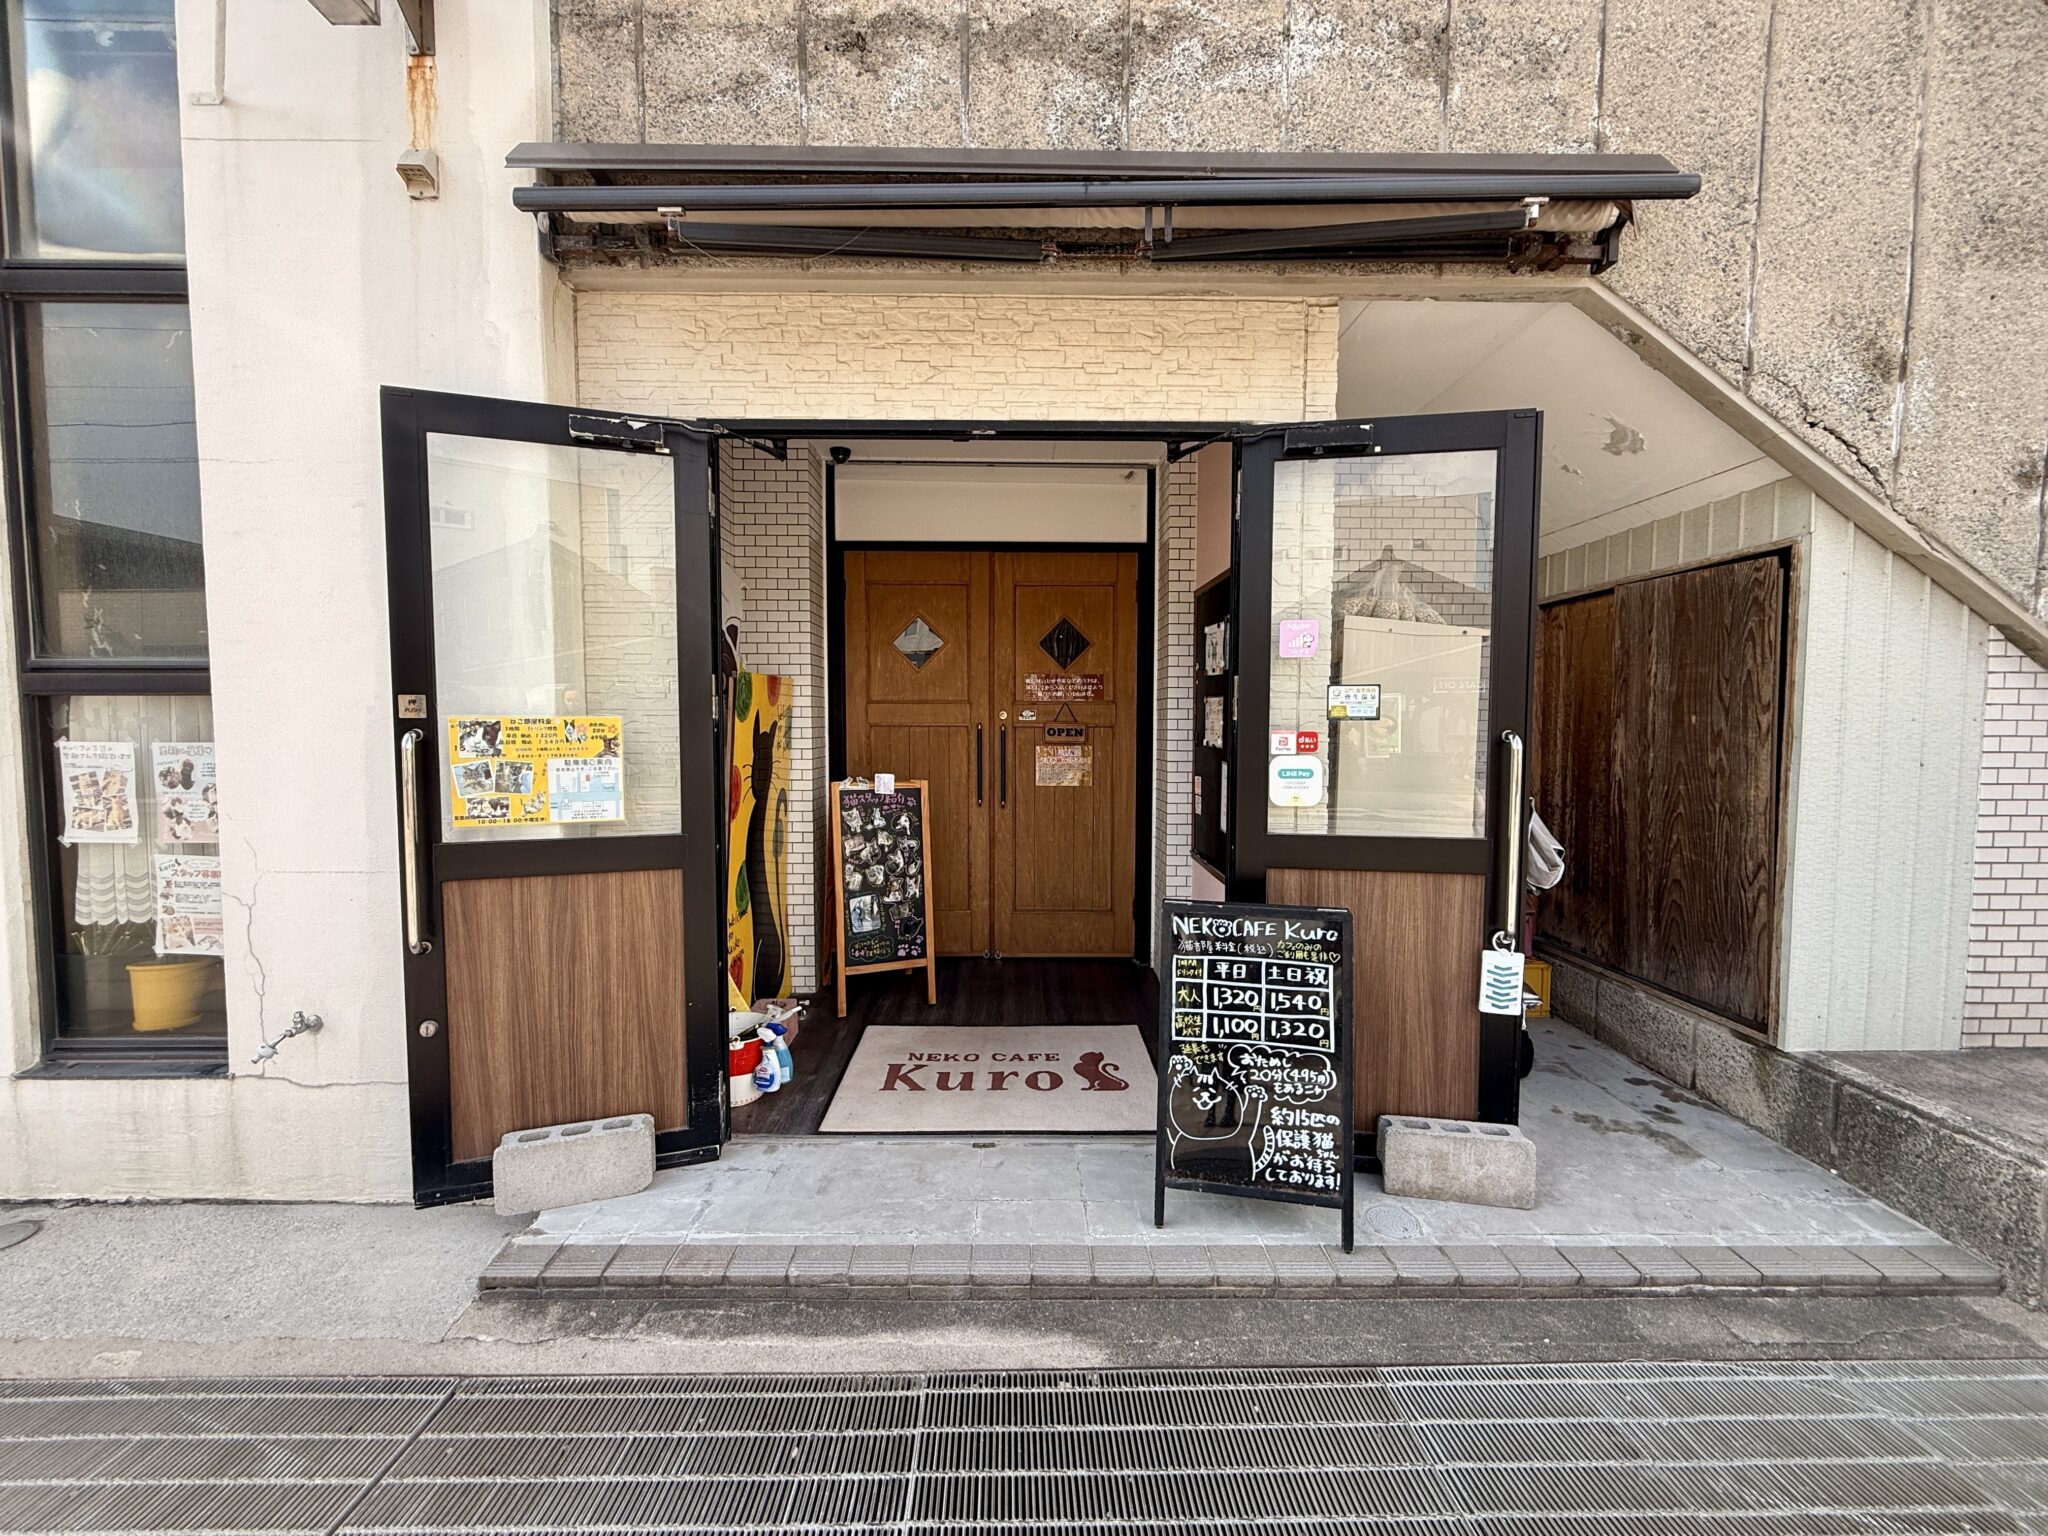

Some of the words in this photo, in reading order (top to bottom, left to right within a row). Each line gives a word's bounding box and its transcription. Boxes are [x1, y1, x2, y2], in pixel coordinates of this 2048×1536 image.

[1046, 727, 1084, 737] OPEN
[1299, 770, 1311, 778] Pay
[1232, 918, 1277, 938] CAFE
[1284, 920, 1339, 942] Kuro
[1276, 941, 1322, 952] カフェのみの
[1213, 961, 1247, 980] 平日
[1267, 965, 1329, 985] 土日祝
[1177, 985, 1202, 1003] 大人
[1175, 1013, 1202, 1030] 高校生
[1182, 1027, 1201, 1037] 以下
[907, 1052, 981, 1062] NEKO
[991, 1052, 1061, 1062] CAFE
[1193, 1051, 1225, 1065] できます
[1239, 1053, 1293, 1068] おためし
[878, 1063, 1064, 1092] Kuro
[1270, 1106, 1341, 1127] 約15匹の
[1275, 1128, 1335, 1151] 保護猫
[1273, 1150, 1336, 1174] がお待ち
[1316, 1148, 1340, 1160] ちゃん
[1265, 1167, 1341, 1191] しております!
